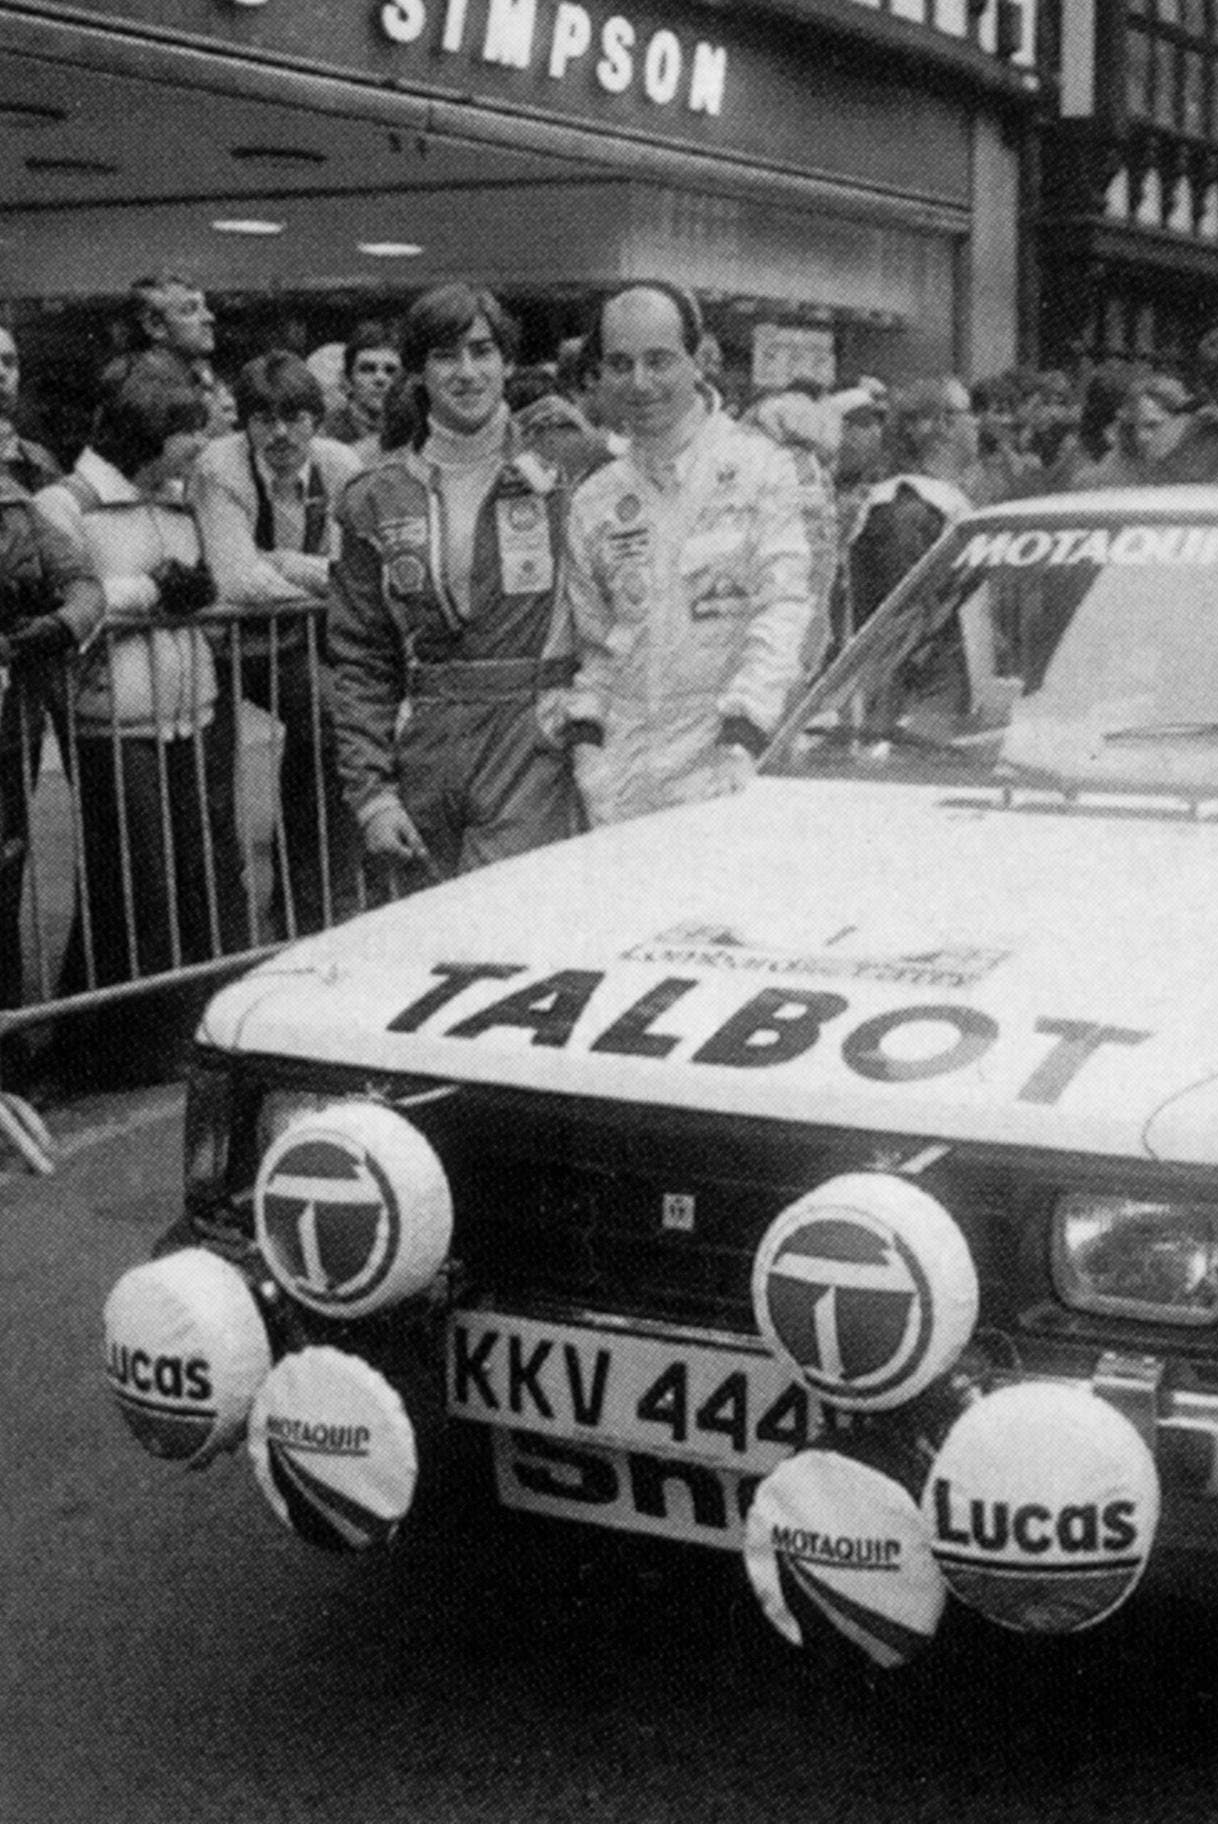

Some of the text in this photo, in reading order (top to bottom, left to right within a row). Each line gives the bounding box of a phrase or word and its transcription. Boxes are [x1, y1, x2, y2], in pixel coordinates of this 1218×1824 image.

[381, 0, 726, 116] SIMPSON
[386, 961, 1156, 1107] TALBOT
[105, 1342, 213, 1401] ucas
[454, 1325, 611, 1427] KKV
[771, 1524, 900, 1563] MOTAQUIP
[935, 1478, 1139, 1554] Lucas
